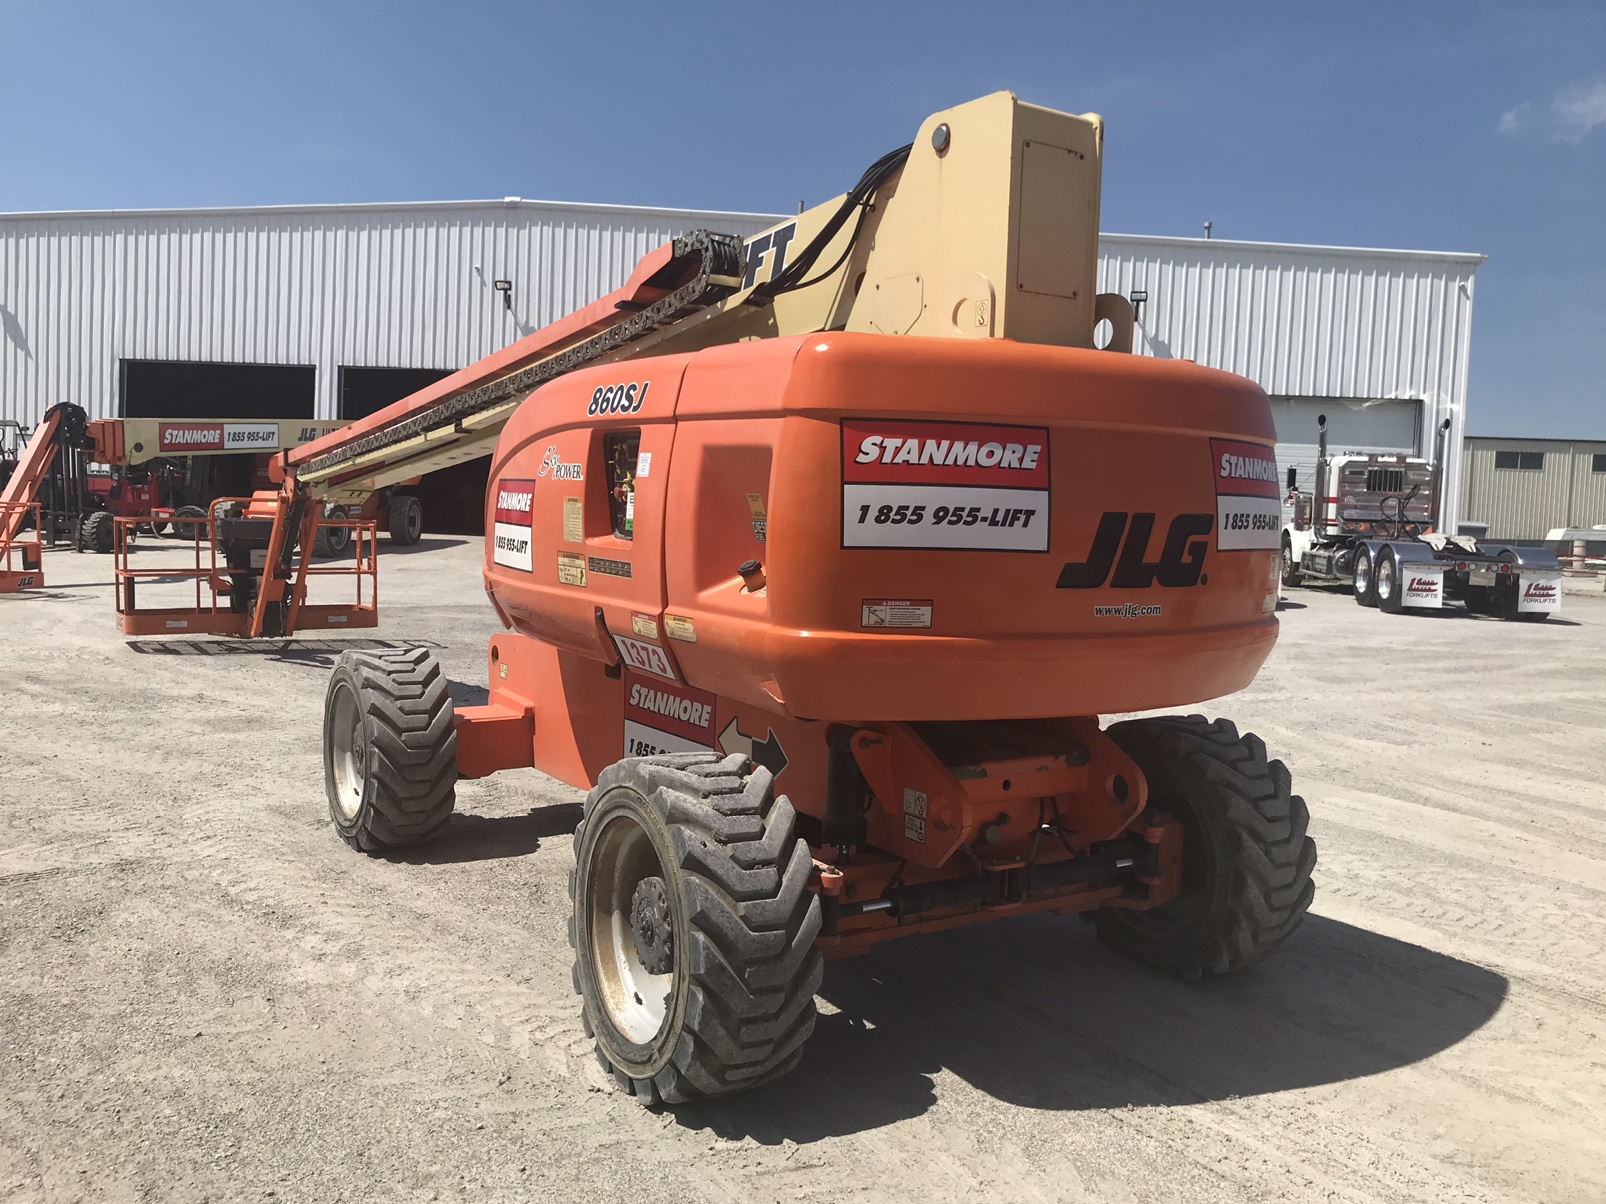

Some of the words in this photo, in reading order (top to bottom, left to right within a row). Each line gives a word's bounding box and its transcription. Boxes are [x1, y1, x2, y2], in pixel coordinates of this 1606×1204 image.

[743, 220, 797, 290] FT
[588, 382, 649, 416] 860SJ
[163, 428, 221, 444] STANMORE
[227, 431, 231, 442] 1
[232, 431, 245, 442] 855
[247, 431, 276, 442] 955-LIFT
[298, 427, 316, 441] JLG
[854, 436, 1042, 469] STANMORE
[553, 463, 583, 480] POWER
[1220, 453, 1277, 483] STANMORE
[497, 490, 532, 512] STANMORE
[858, 505, 870, 524] 1
[874, 505, 926, 525] 855
[931, 506, 1036, 528] 955-LIFT
[1224, 513, 1230, 530] 1
[1231, 513, 1250, 531] 855
[1252, 514, 1279, 532] 955-LIFT
[506, 538, 528, 554] 955-LIFT
[18, 576, 34, 588] JLG
[1094, 603, 1162, 619] www.jlg.com
[621, 640, 668, 675] 1373
[629, 684, 712, 728] STANMORE
[630, 738, 635, 753] 1
